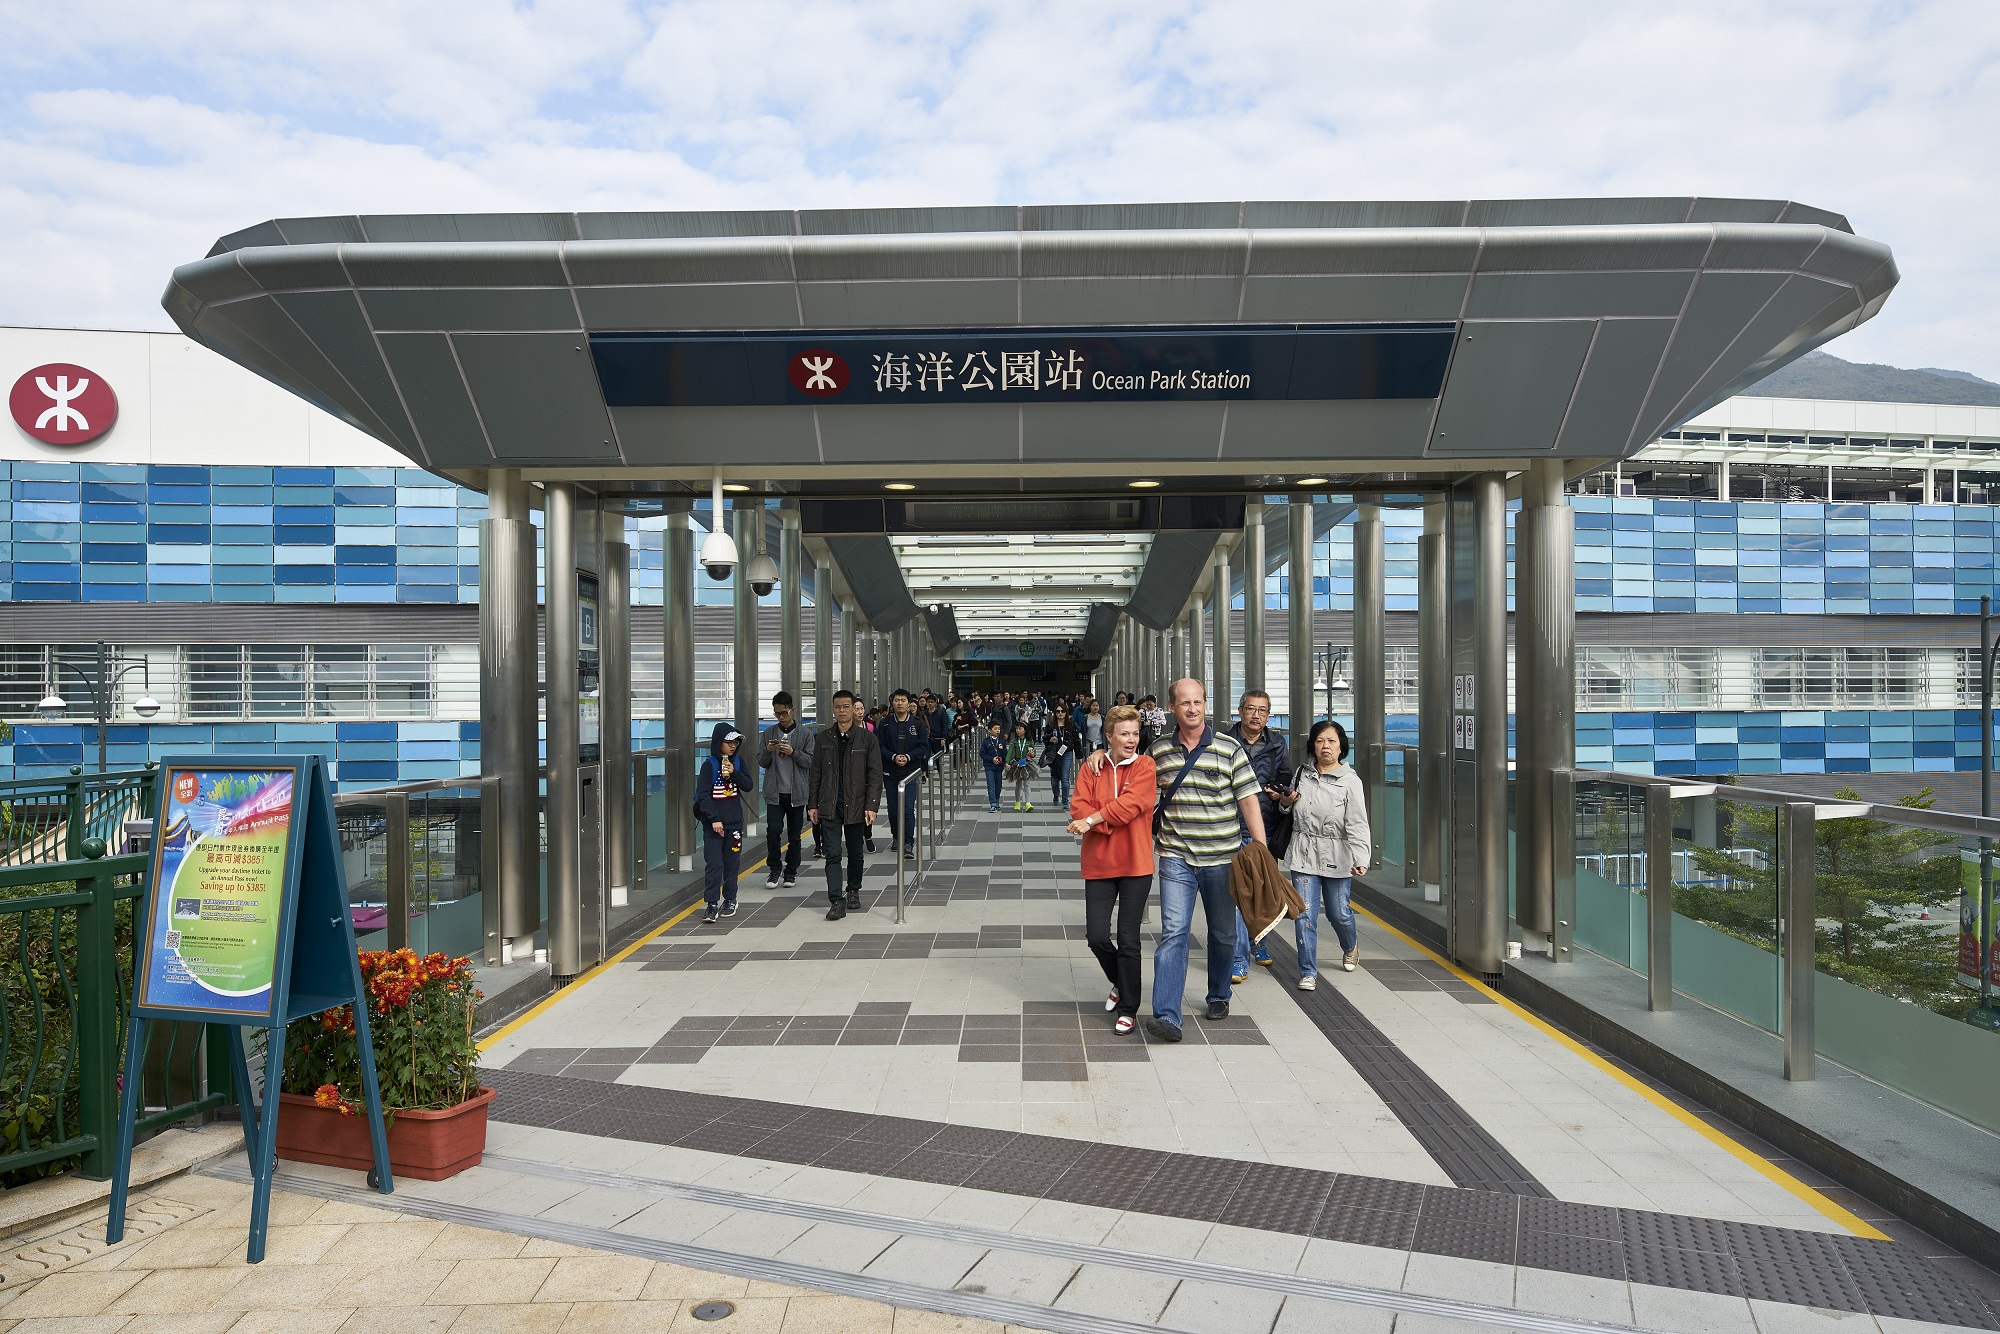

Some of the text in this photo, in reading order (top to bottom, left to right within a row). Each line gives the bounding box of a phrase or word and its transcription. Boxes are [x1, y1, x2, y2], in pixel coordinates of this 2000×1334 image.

[871, 349, 1086, 393] 海洋公園站
[1092, 368, 1251, 391] Ocean Park Station
[585, 614, 592, 639] B
[179, 778, 193, 790] NEW
[250, 813, 289, 828] Annual Pass
[198, 866, 219, 874] Upgrade
[231, 867, 251, 875] daytime
[251, 867, 265, 875] ticket
[200, 880, 266, 893] Saving up to $385!
